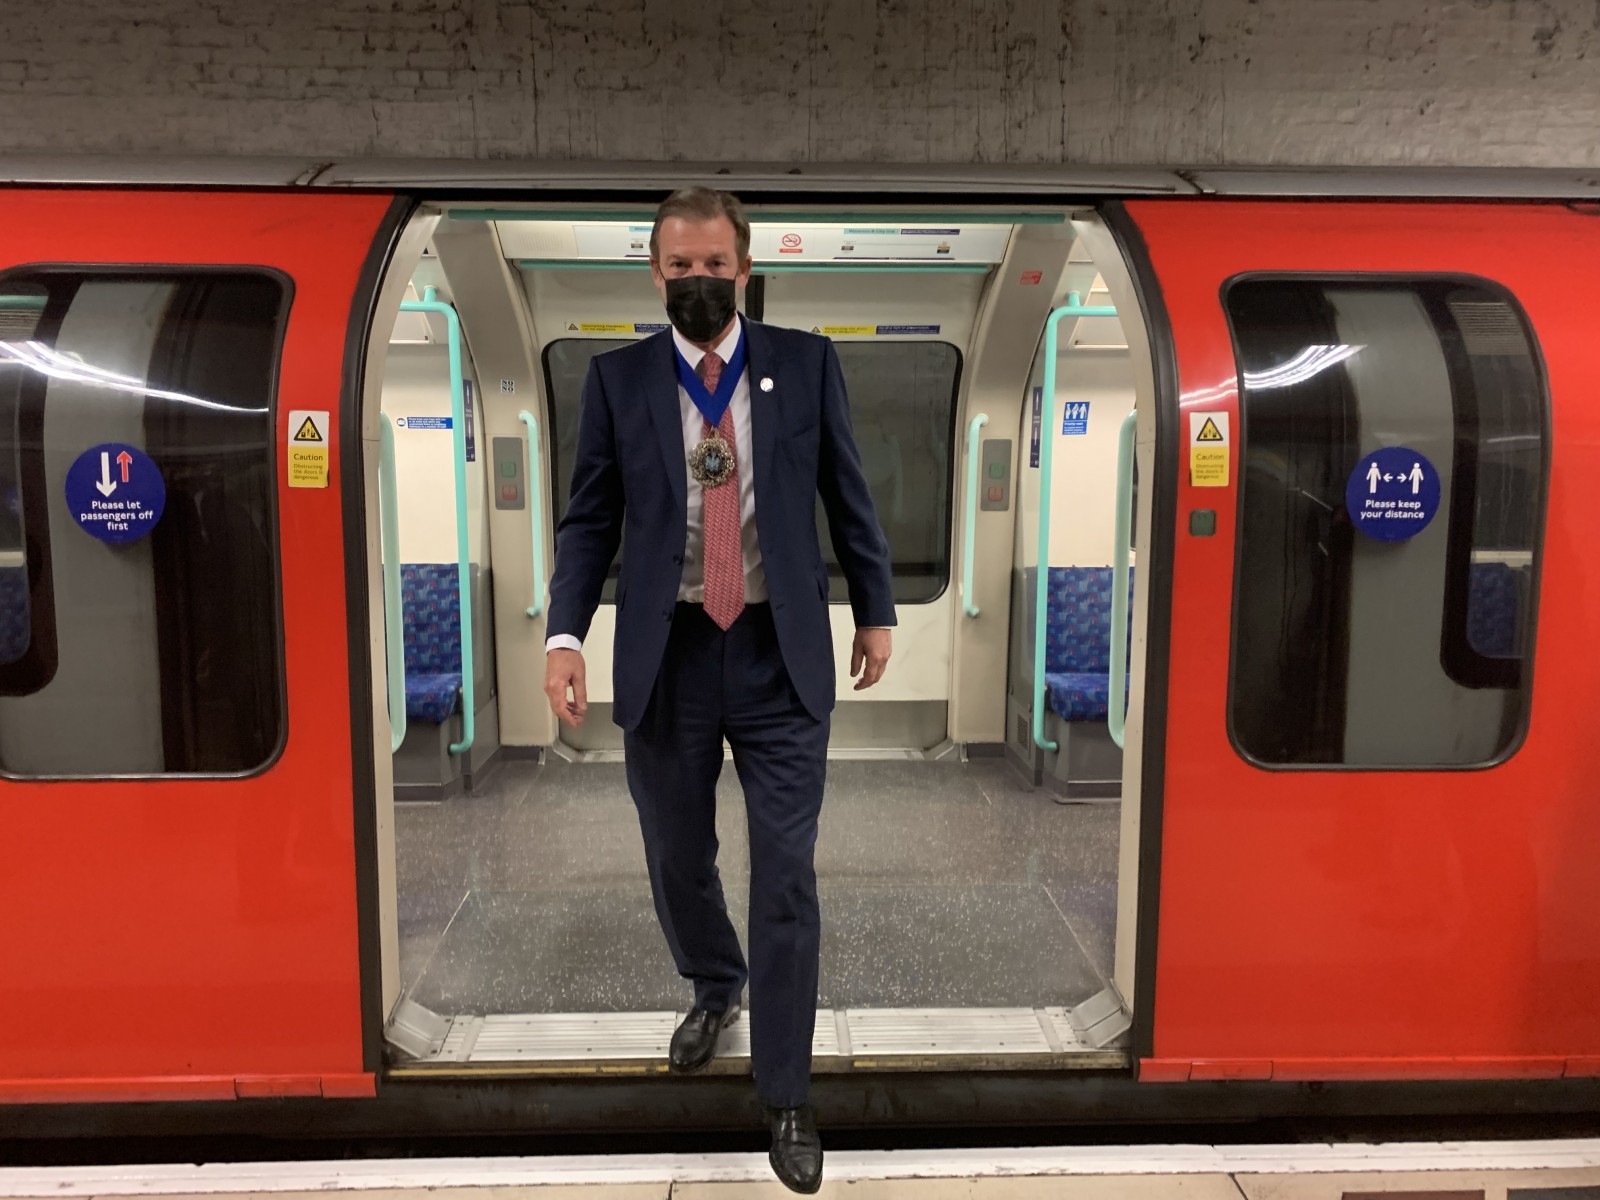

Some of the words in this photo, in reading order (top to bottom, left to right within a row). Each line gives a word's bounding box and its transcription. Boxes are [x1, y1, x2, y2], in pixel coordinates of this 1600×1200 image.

[293, 453, 324, 461] Caution
[91, 500, 125, 510] Please
[126, 500, 141, 510] let
[1365, 499, 1396, 509] Please
[1398, 499, 1422, 510] keep
[80, 512, 136, 522] passengers
[138, 510, 154, 520] off
[1360, 511, 1383, 520] your
[1384, 509, 1425, 519] distance
[106, 521, 129, 531] first
